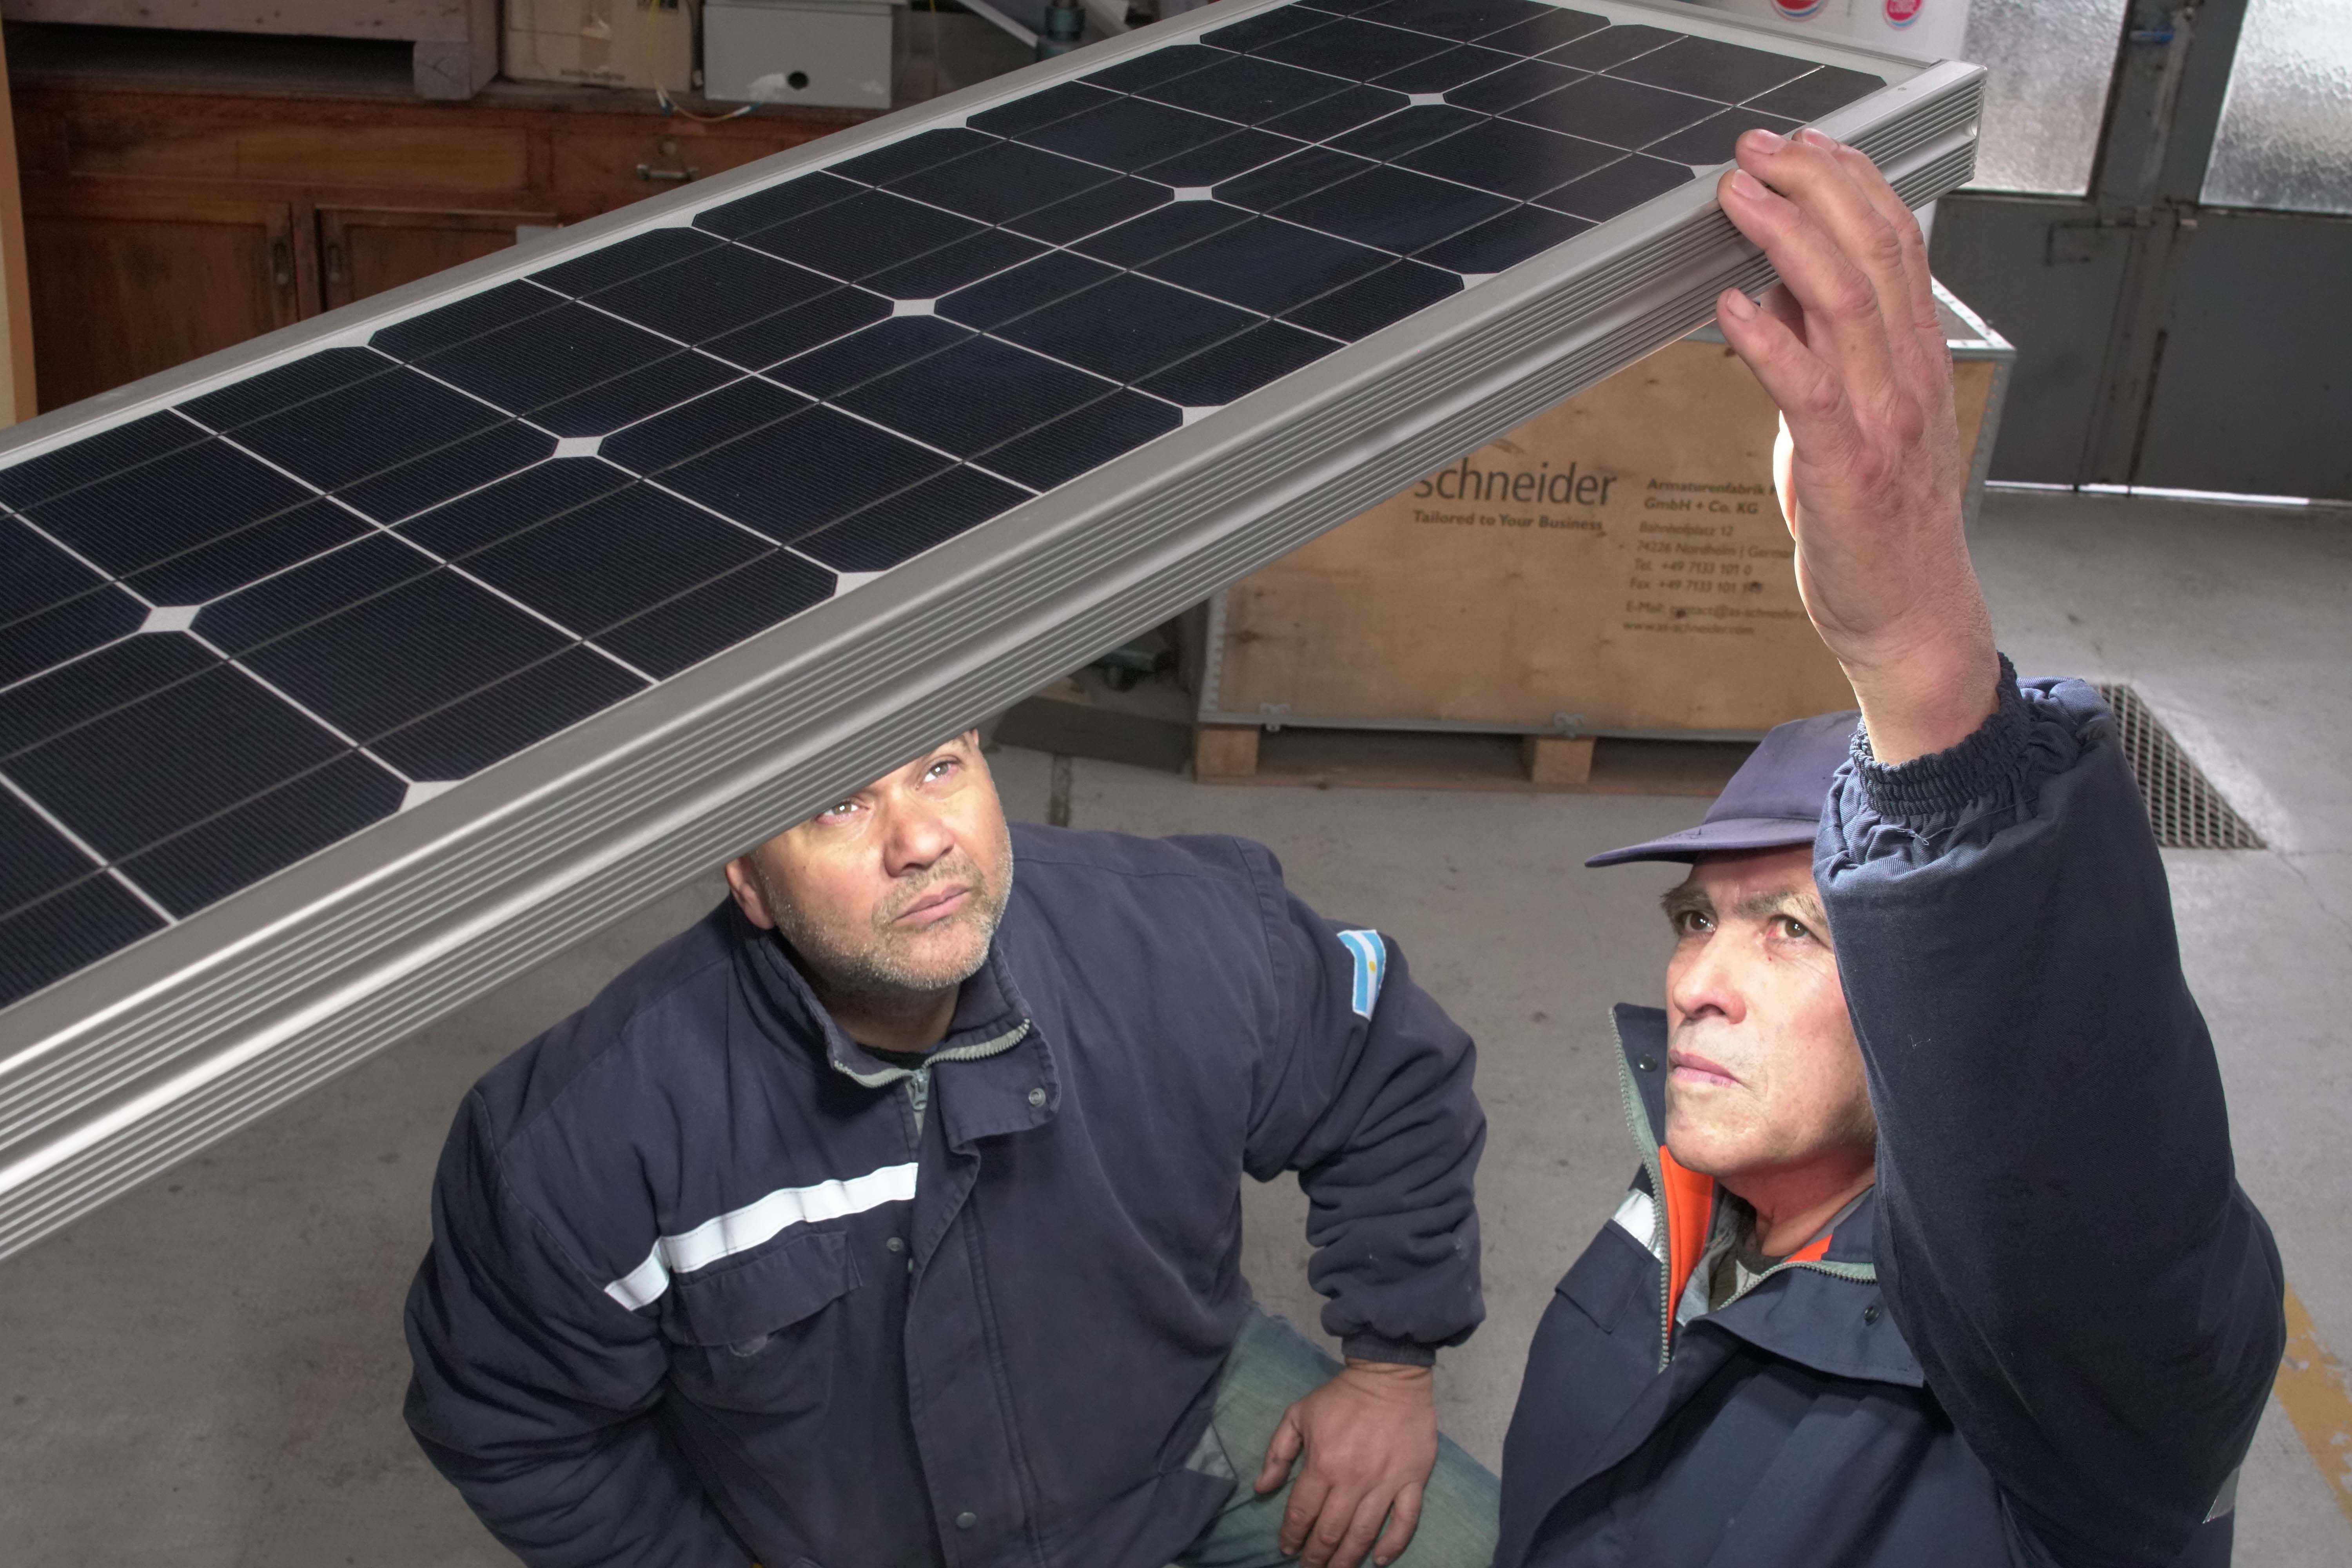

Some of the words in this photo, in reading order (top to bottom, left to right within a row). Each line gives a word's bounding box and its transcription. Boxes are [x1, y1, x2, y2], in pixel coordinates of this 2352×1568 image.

[1647, 478, 1764, 495] Armaturenfabrik
[1644, 497, 1690, 511] GmbH
[1736, 503, 1758, 514] KG
[1414, 511, 1474, 524] Tailored
[1480, 514, 1495, 525] to
[1499, 514, 1534, 527] Your
[1539, 515, 1603, 530] Business
[1722, 525, 1733, 537] 12
[1662, 561, 1684, 572] +49
[1689, 562, 1715, 574] 7133
[1660, 580, 1682, 591] +49
[1687, 581, 1713, 592] 7133
